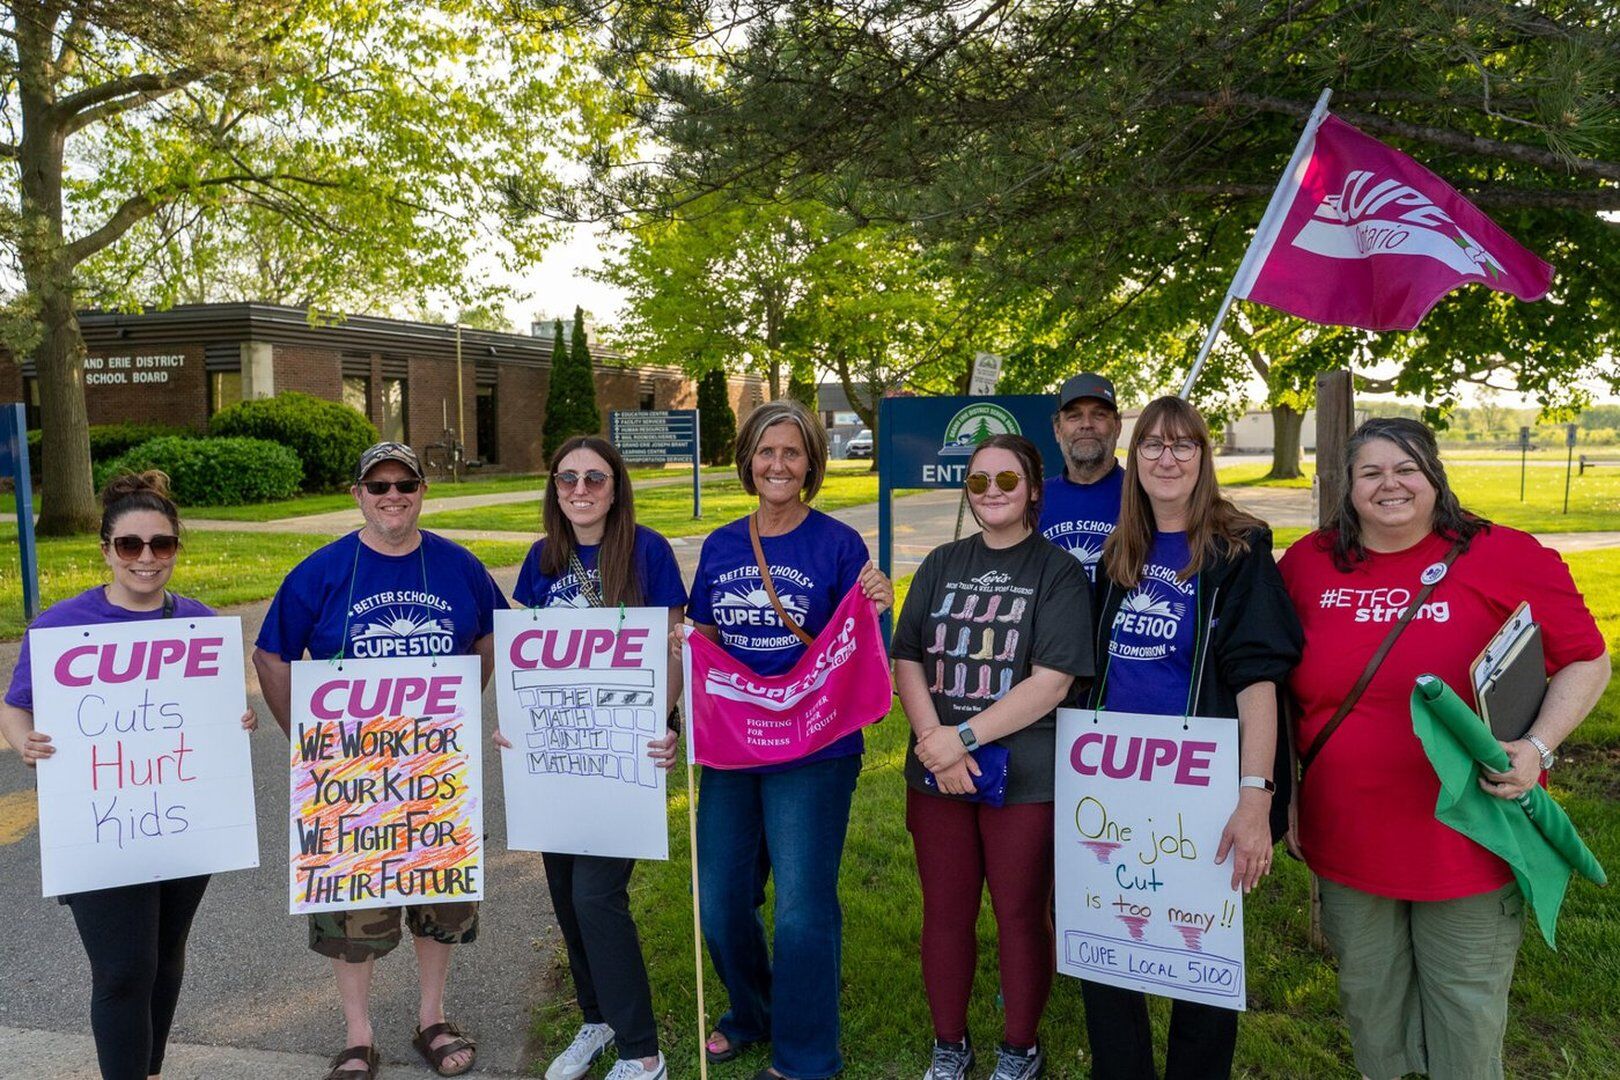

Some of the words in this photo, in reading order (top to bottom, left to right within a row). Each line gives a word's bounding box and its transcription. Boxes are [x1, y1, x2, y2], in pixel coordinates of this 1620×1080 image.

[1336, 170, 1455, 227] CUPE
[83, 359, 104, 369] AND
[108, 357, 131, 368] ERIE
[136, 355, 185, 367] DISTRICT
[86, 373, 128, 384] SCHOOL
[132, 371, 168, 383] BOARD
[1043, 521, 1073, 540] ETTER
[1076, 520, 1117, 534] SCHOOL
[551, 574, 579, 593] BETTE
[719, 566, 760, 583] BETTER
[353, 591, 395, 615] BETTER
[396, 590, 448, 610] SCHOOLS
[1320, 588, 1410, 609] #ETFO
[713, 609, 762, 626] CUPE
[1111, 611, 1137, 633] PE
[1135, 616, 1178, 640] 5100
[353, 638, 408, 658] CUPE
[409, 635, 453, 655] 5100
[509, 628, 650, 669] CUPE
[1119, 644, 1166, 657] TOMORROW
[54, 637, 224, 687] CUPE
[310, 675, 463, 720] CUPE
[541, 690, 591, 706] THE
[730, 672, 801, 702] CUPE
[77, 688, 184, 737] Cuts
[531, 709, 588, 728] MATH
[746, 718, 792, 728] FIGHTING
[299, 721, 334, 762] WE
[339, 720, 410, 760] WORK
[413, 716, 462, 755] FOR
[549, 731, 603, 748] AIN'T
[747, 728, 763, 736] FOR
[747, 736, 790, 746] FAIRNESS
[92, 732, 196, 790] Hurt
[529, 753, 610, 774] MATHIN'
[1069, 732, 1217, 787] CUPE
[310, 768, 378, 806] YOUR
[383, 767, 457, 802] KIDS
[92, 791, 189, 849] Kids
[296, 817, 333, 856] WE
[338, 814, 405, 854] FIGHT
[406, 810, 461, 852] FOR
[1075, 796, 1133, 842] One
[1138, 812, 1197, 865] job
[299, 864, 378, 904] THEIR
[380, 858, 478, 899] FUTURE
[1115, 864, 1164, 892] Cut
[1085, 887, 1102, 909] is
[1112, 894, 1152, 918] too
[1079, 941, 1118, 966] CUPE
[1129, 953, 1178, 978] LOCAL
[1188, 961, 1233, 986] 5100
